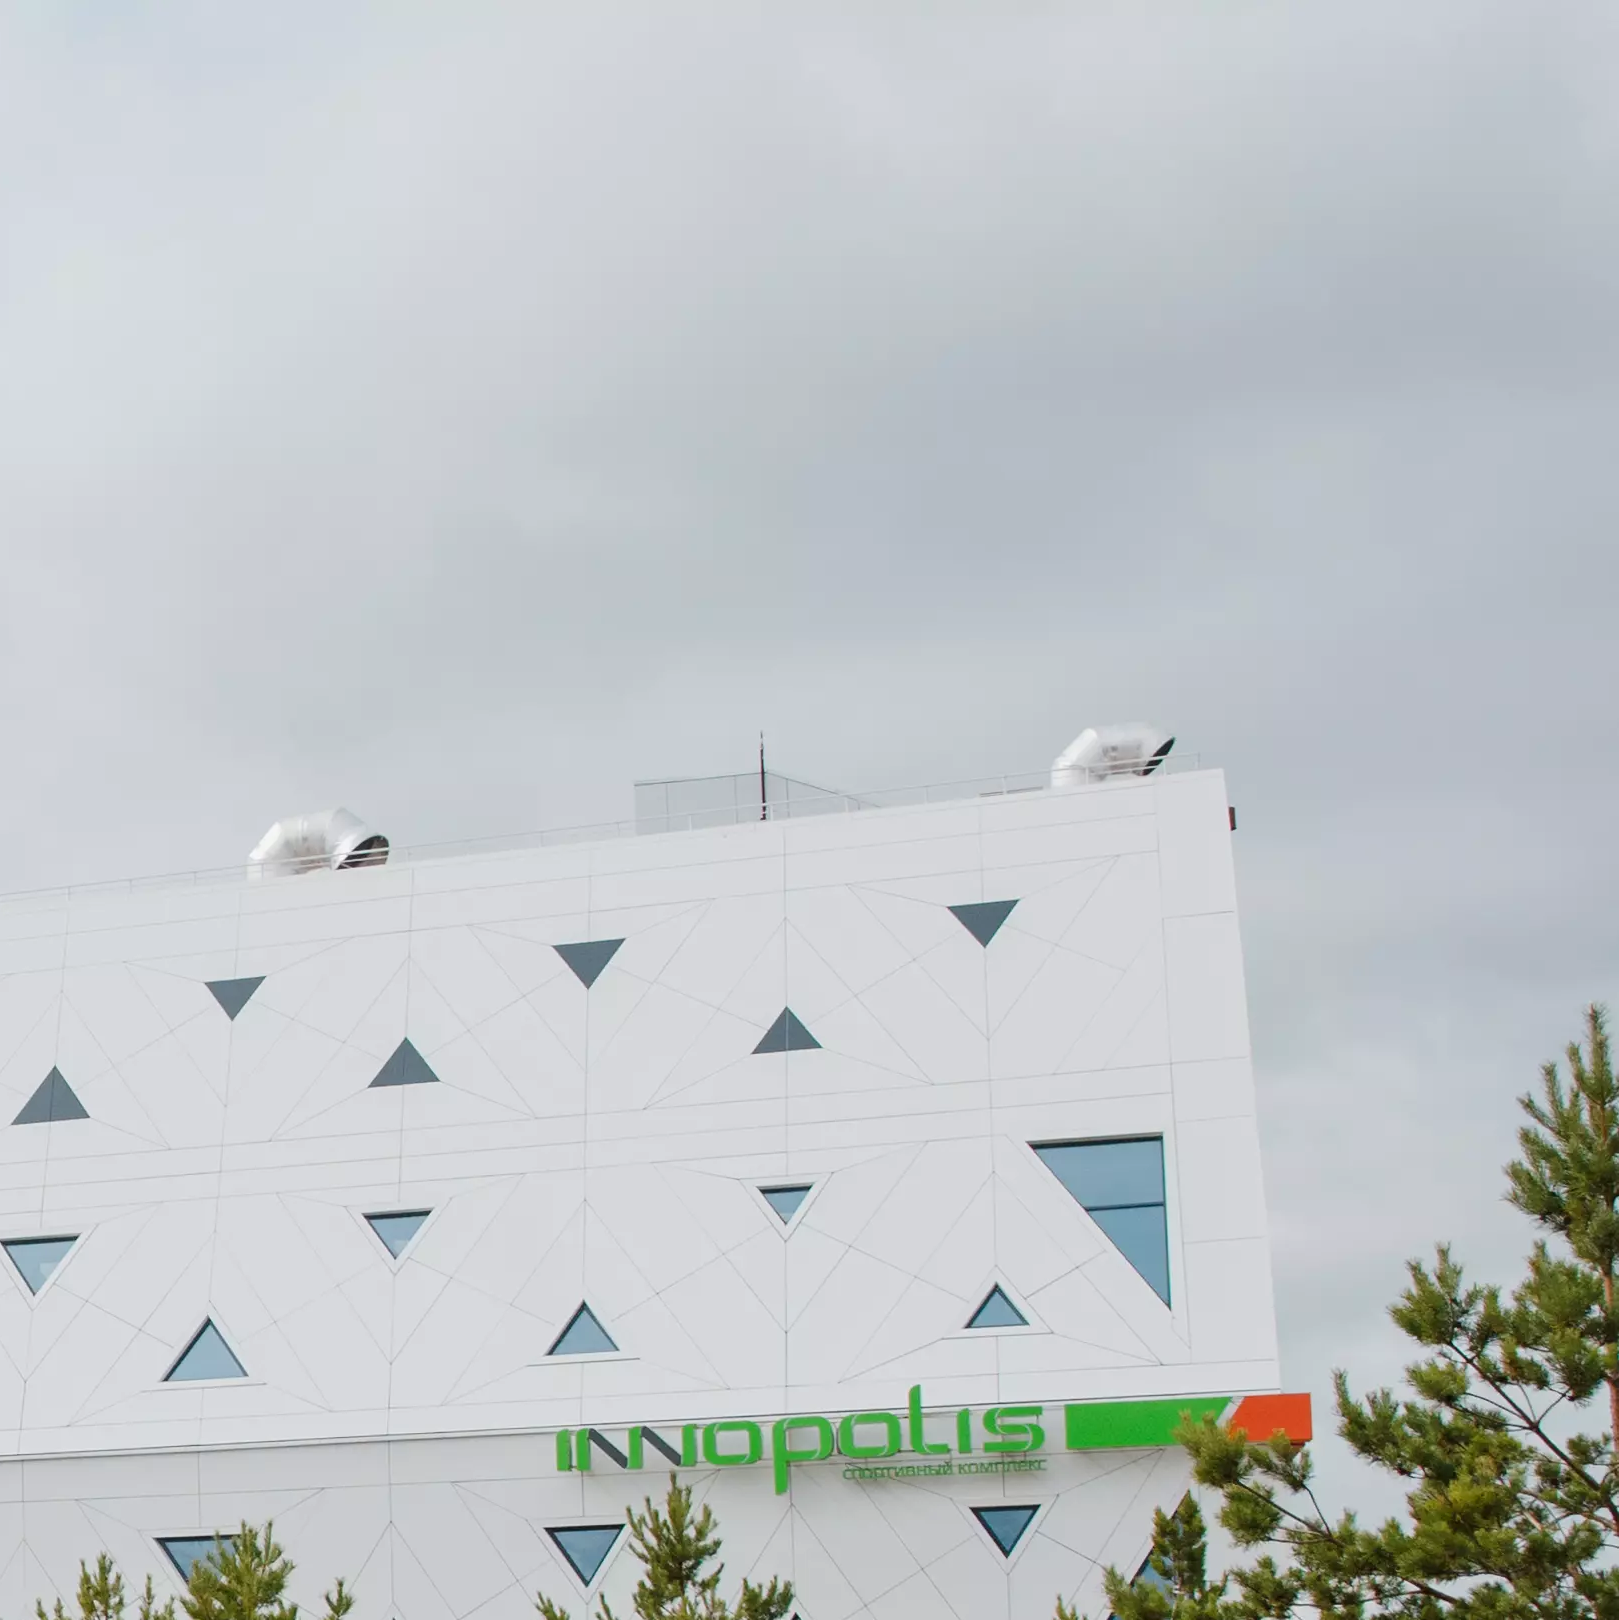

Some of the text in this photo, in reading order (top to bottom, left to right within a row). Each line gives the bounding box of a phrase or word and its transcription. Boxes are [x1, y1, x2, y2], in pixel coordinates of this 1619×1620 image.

[556, 1384, 1045, 1495] innopolis
[842, 1459, 1047, 1481] спортивный комплекс
